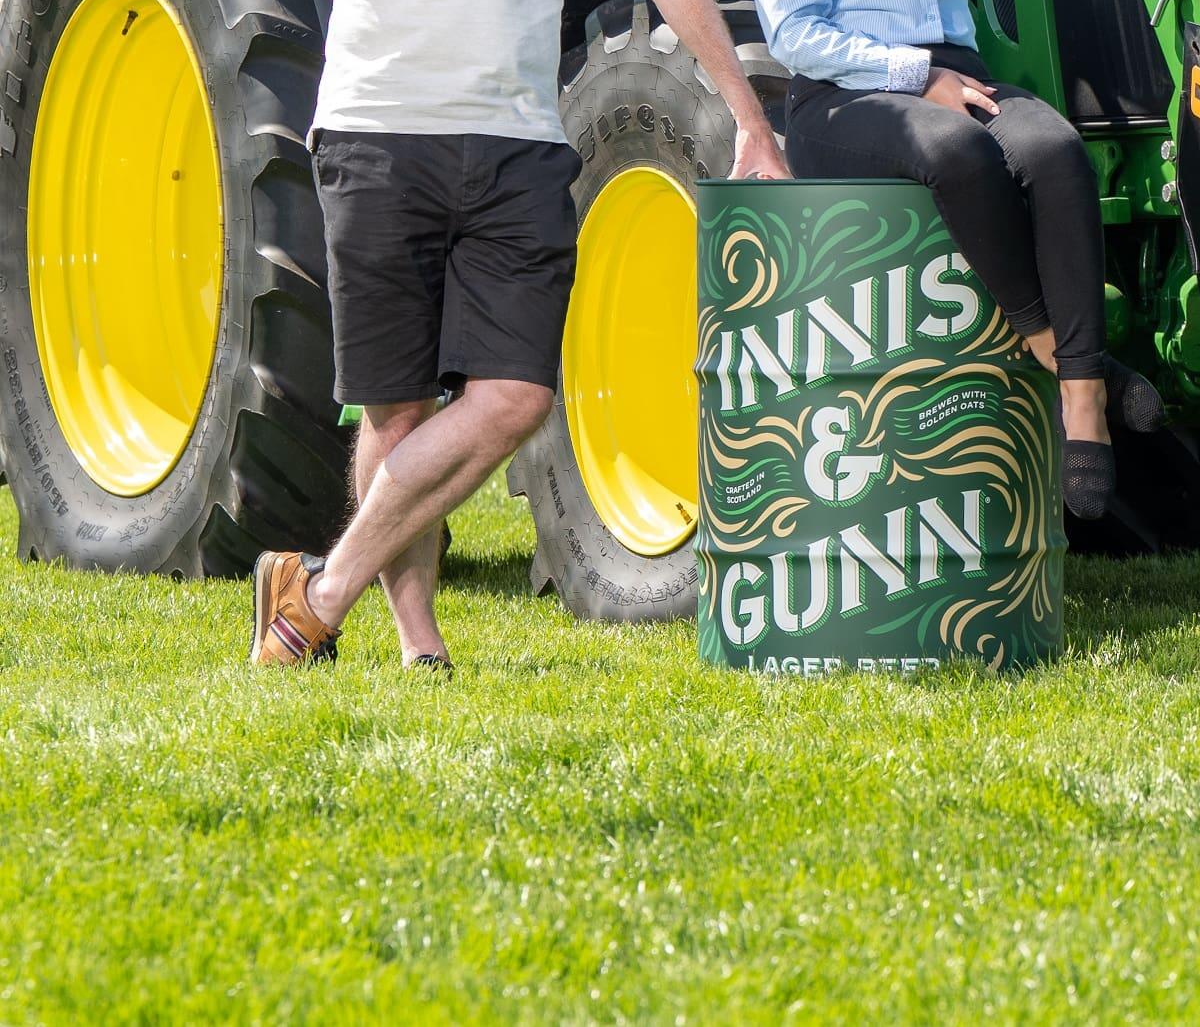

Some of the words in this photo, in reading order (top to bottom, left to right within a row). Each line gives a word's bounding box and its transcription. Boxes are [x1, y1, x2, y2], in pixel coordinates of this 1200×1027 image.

[717, 253, 981, 414] INNIS
[919, 394, 959, 420] BREWED
[961, 390, 986, 399] WITH
[919, 405, 958, 430] GOLDEN
[960, 401, 985, 410] OATS
[803, 406, 884, 504] &
[726, 479, 755, 494] CRAFTED
[756, 471, 765, 482] IN
[726, 484, 762, 504] SCOTLAND
[721, 489, 987, 645] GUNN
